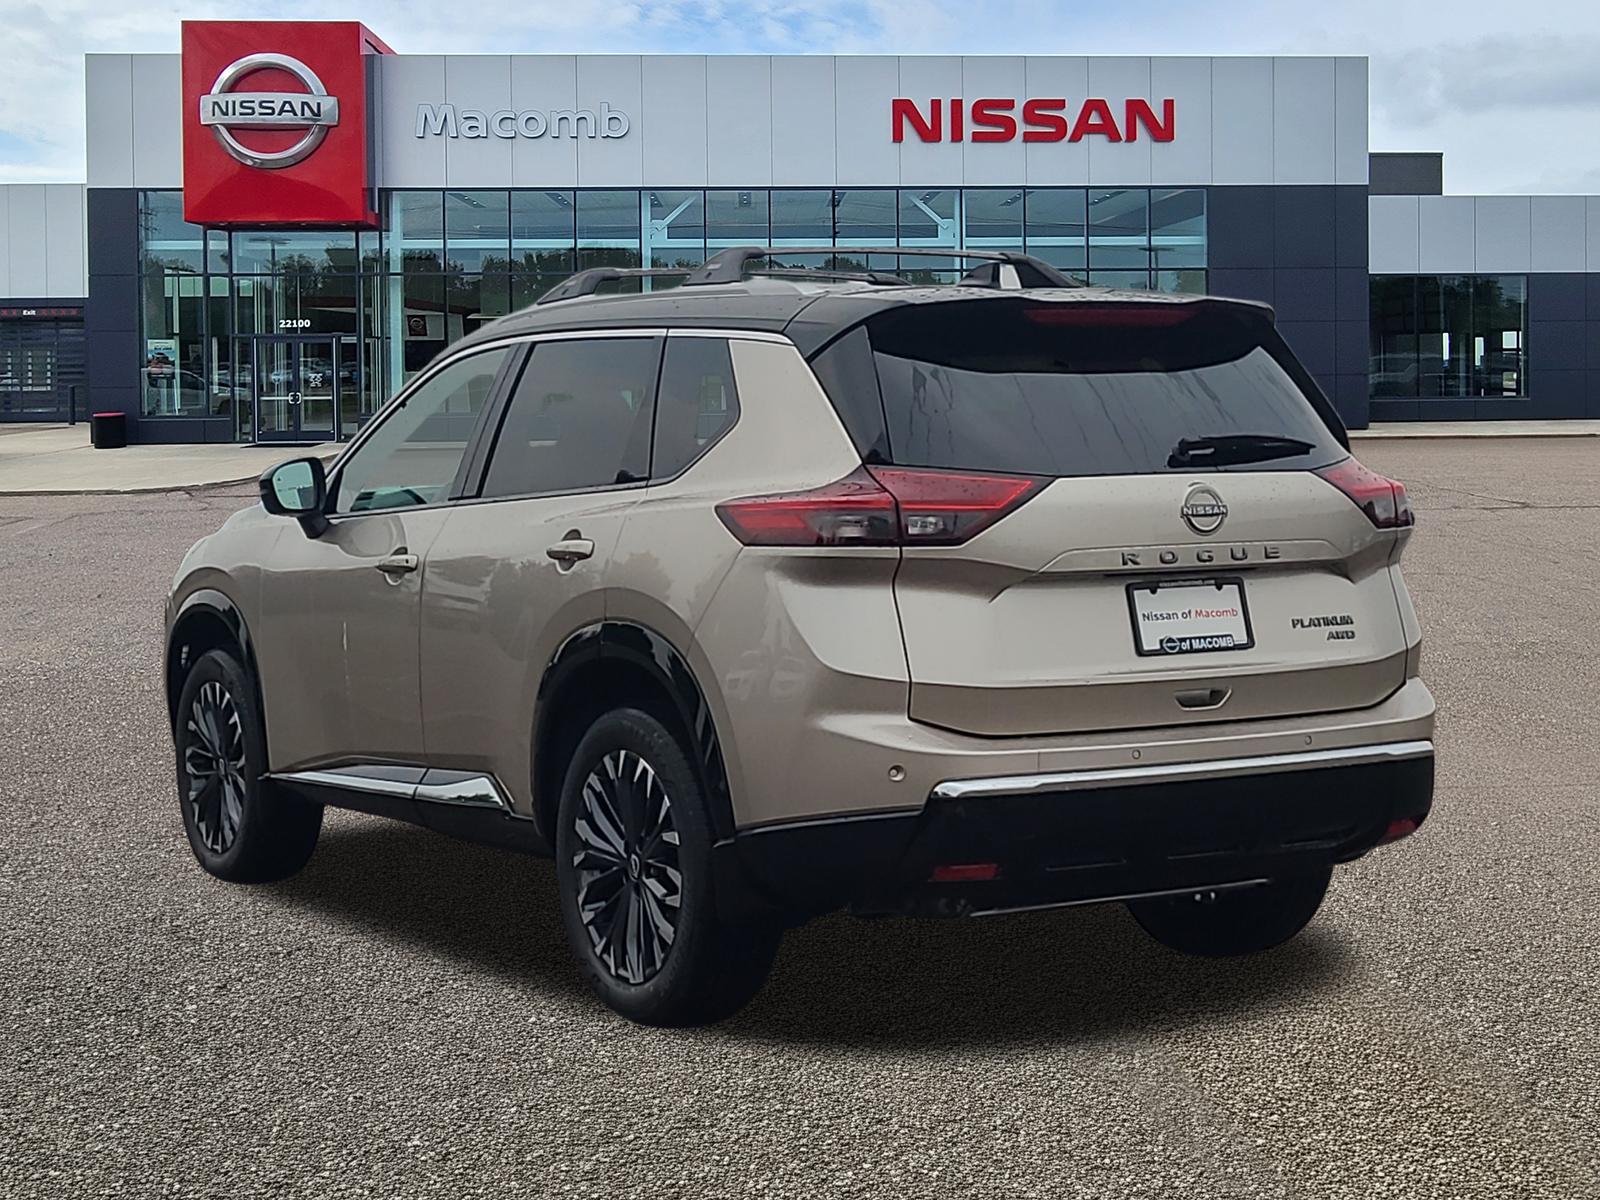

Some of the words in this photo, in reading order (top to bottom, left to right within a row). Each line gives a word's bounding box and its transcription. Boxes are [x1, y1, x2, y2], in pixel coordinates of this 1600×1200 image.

[211, 100, 322, 118] NISSAN
[415, 102, 630, 139] Macomb
[893, 98, 1175, 143] NISSAN
[279, 319, 311, 328] 22100
[1183, 505, 1227, 515] NISSAN
[1121, 546, 1281, 566] ROGUE
[1142, 610, 1179, 622] Nissan
[1181, 609, 1192, 620] of
[1194, 607, 1238, 619] Macomb
[1291, 615, 1354, 629] PLATINUM
[1326, 630, 1356, 640] AWD
[1180, 640, 1190, 650] of
[1191, 637, 1234, 650] MACOMB
